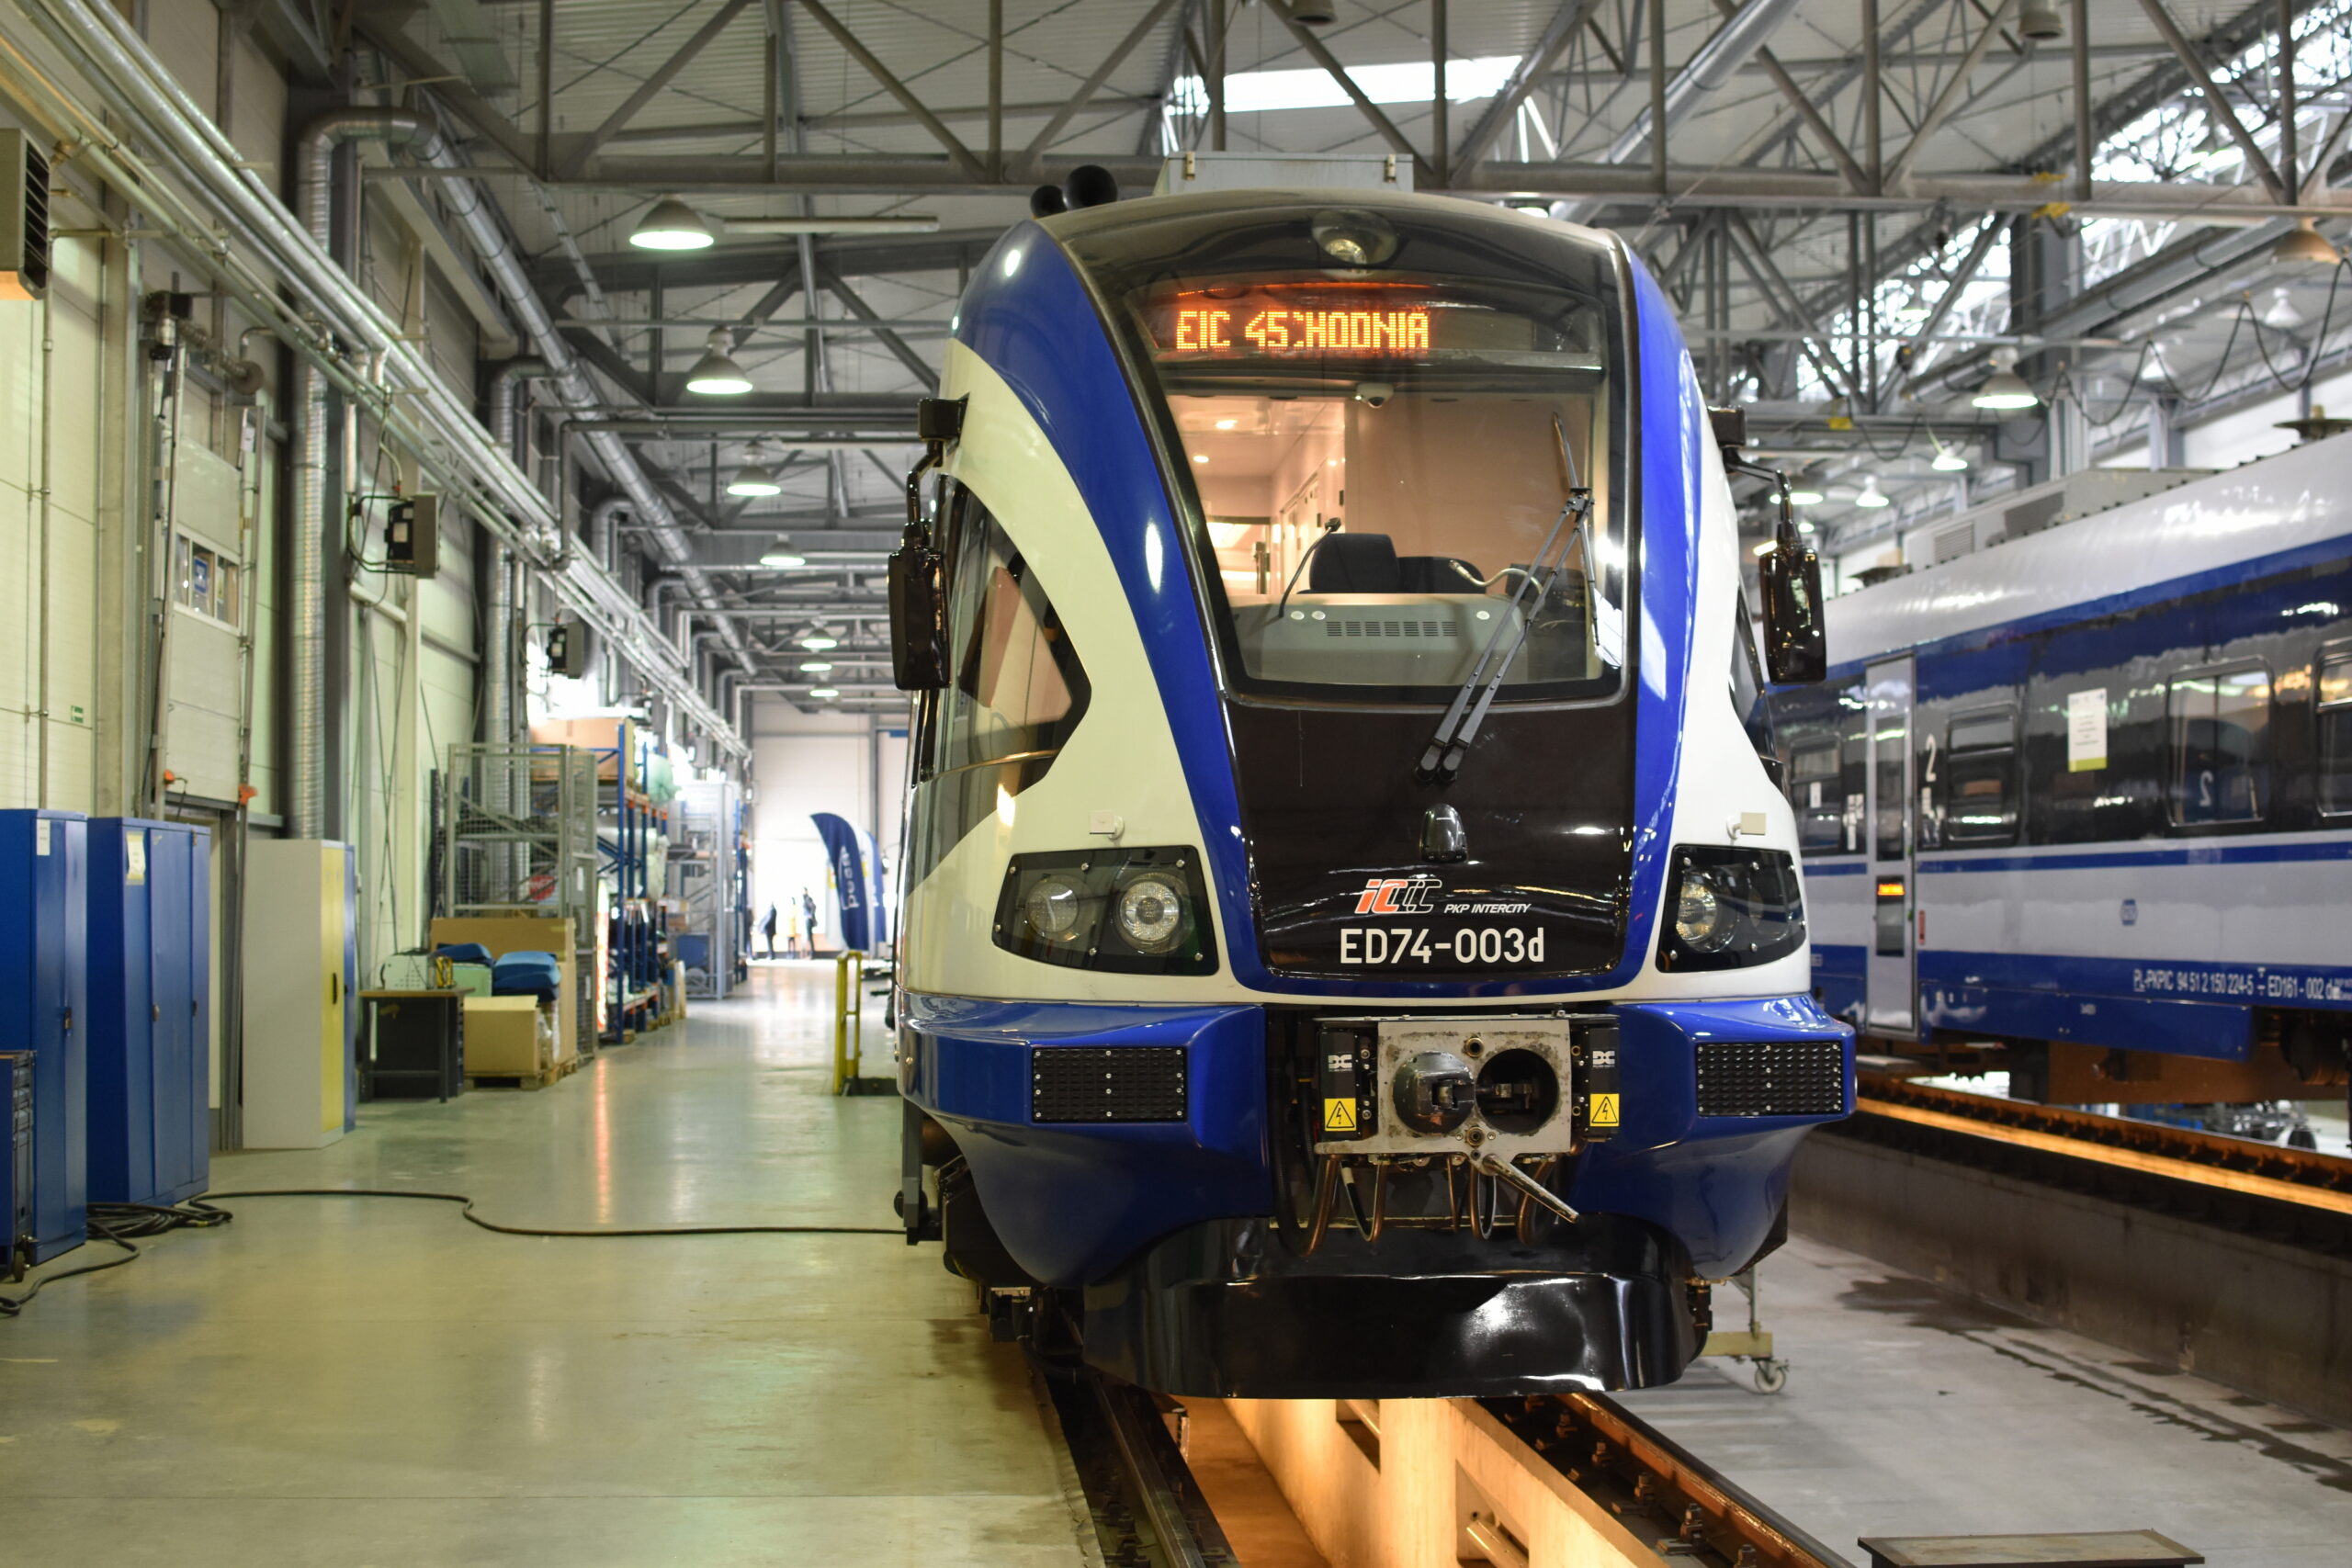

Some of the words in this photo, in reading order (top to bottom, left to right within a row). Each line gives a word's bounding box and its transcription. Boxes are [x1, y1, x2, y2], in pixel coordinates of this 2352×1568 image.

[1176, 310, 1230, 349] EIC
[1926, 734, 1937, 782] 2
[1443, 903, 1470, 914] PKP
[1471, 903, 1532, 914] INTERCITY
[1340, 927, 1544, 964] ED74-003d
